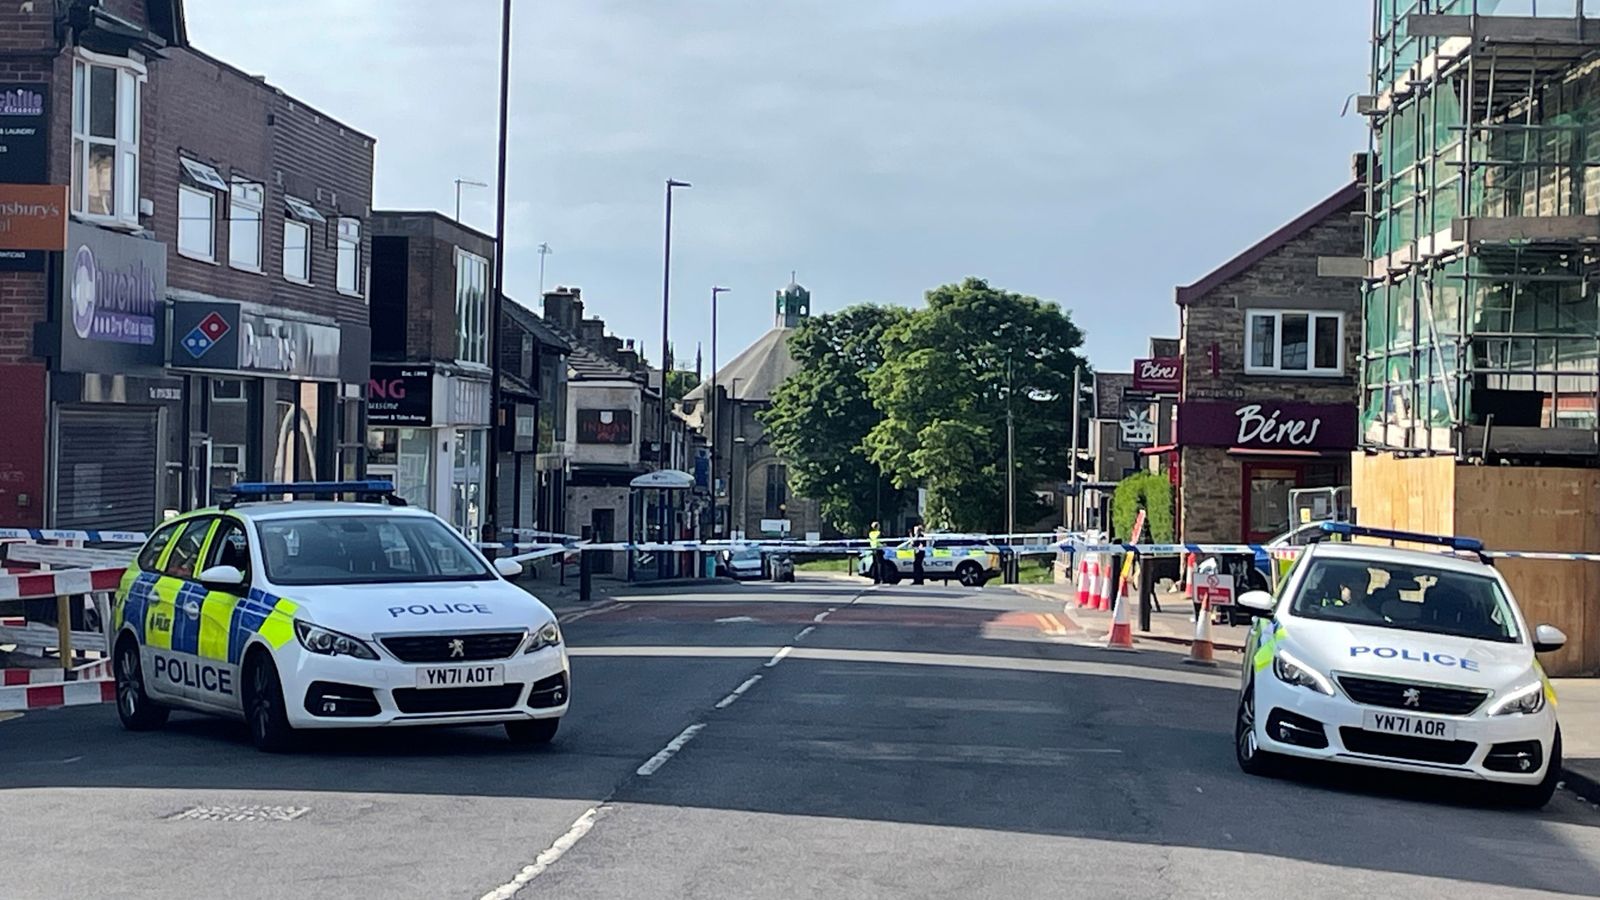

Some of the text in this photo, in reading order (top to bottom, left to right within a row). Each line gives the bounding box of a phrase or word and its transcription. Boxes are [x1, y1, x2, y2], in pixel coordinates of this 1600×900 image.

[1141, 361, 1177, 378] Béres
[368, 379, 406, 399] NG
[1235, 404, 1320, 445] Béres
[388, 603, 493, 618] POLICE
[1350, 646, 1481, 672] POLICE
[154, 655, 233, 695] POLICE
[426, 667, 495, 685] YN71 AOT
[1375, 714, 1446, 737] YN71 AOR
